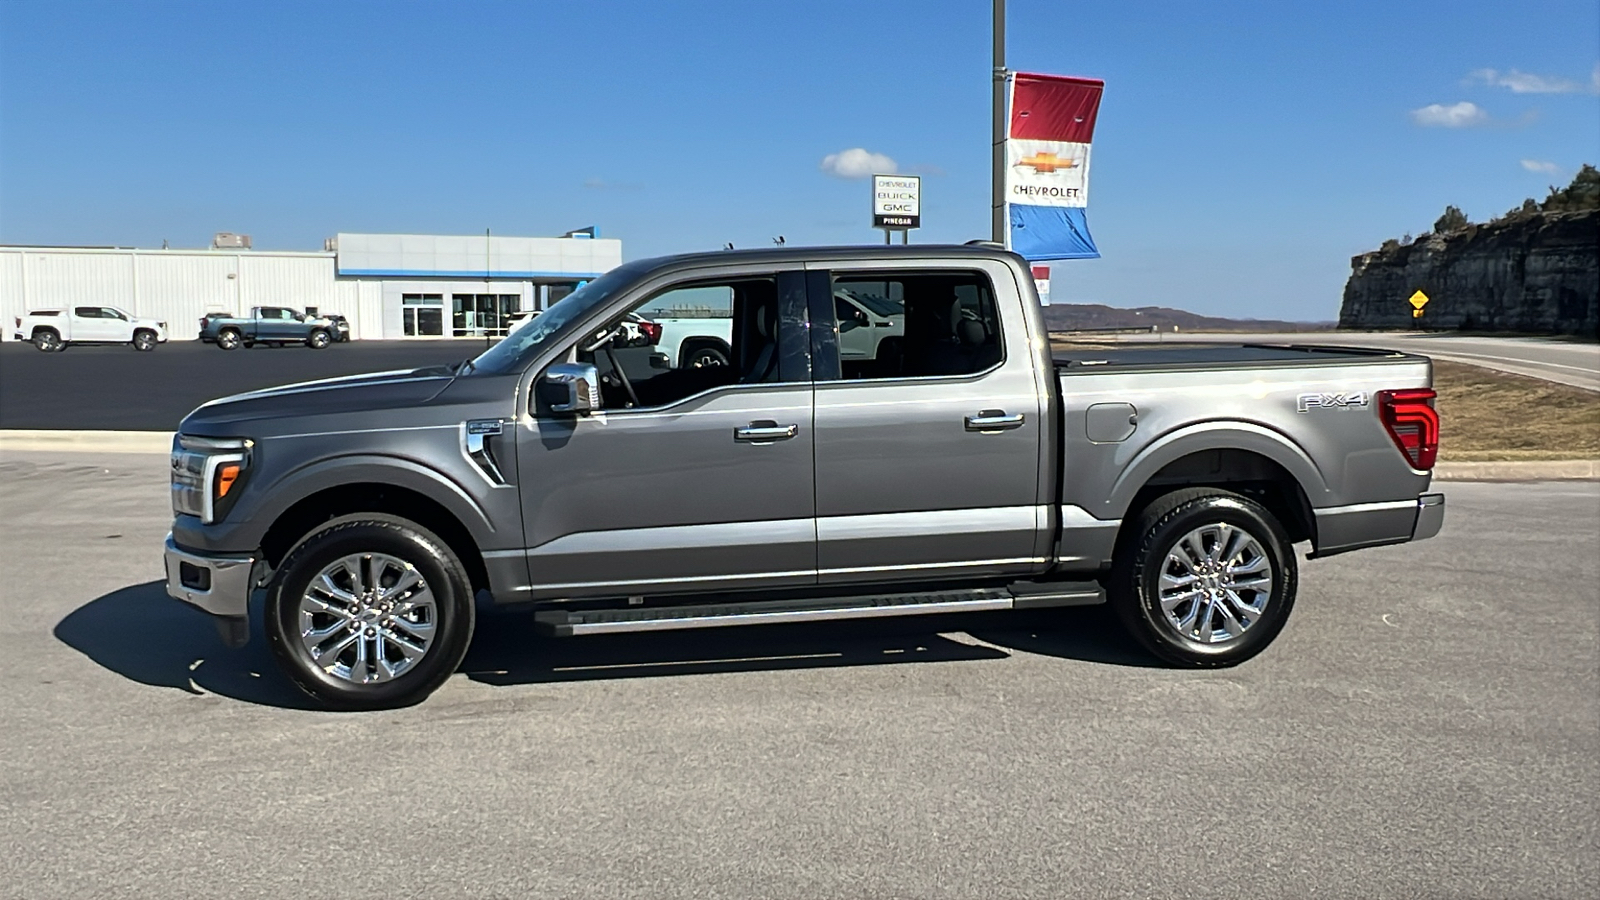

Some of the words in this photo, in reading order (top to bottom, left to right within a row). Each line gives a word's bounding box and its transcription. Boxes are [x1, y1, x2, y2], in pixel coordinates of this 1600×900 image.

[877, 192, 916, 200] BUICK
[1013, 184, 1079, 198] CHEVROLET
[1297, 391, 1369, 413] FX4
